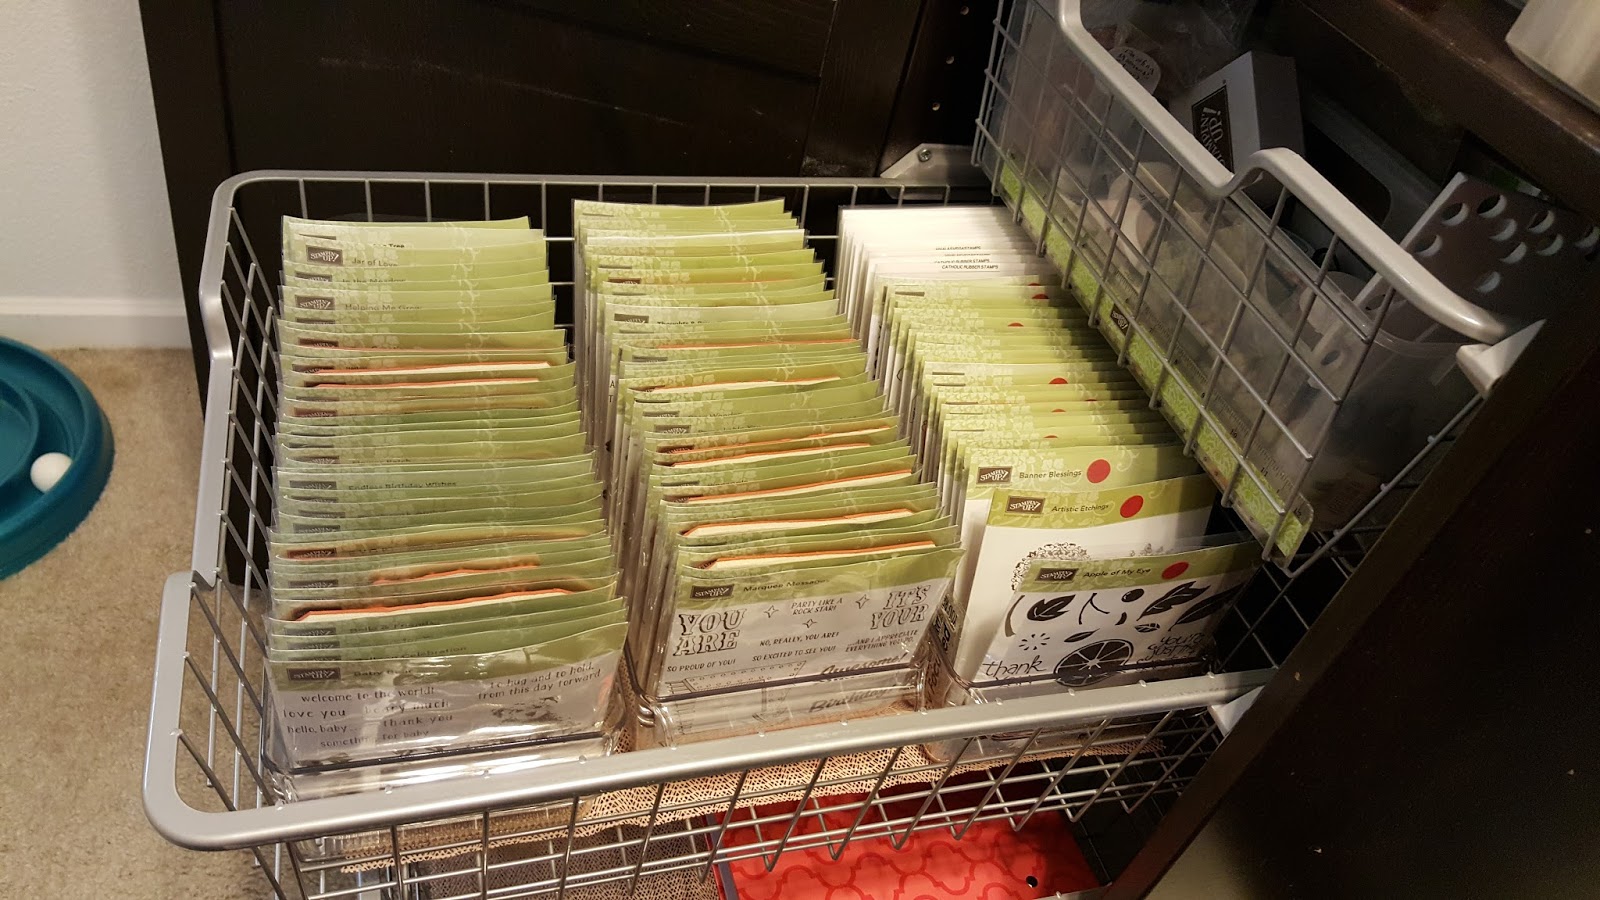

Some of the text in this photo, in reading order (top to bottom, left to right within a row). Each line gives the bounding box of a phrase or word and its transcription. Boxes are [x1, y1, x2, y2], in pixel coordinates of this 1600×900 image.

[1048, 469, 1082, 478] Blessings
[1080, 503, 1109, 512] Etchings
[1083, 570, 1108, 578] Apple
[743, 583, 784, 592] Marquee
[882, 584, 931, 610] IT'S
[791, 600, 816, 609] PARTY
[818, 598, 835, 606] LIKE
[792, 607, 813, 615] ROCK
[870, 603, 929, 630] YOUR
[678, 608, 747, 636] YOU
[759, 639, 771, 647] NO,
[773, 635, 803, 645] REALLY,
[804, 633, 820, 641] YOU
[875, 629, 919, 642] APPRECIATE
[672, 629, 741, 657] ARE
[845, 642, 888, 652] EVERYTHING
[763, 650, 793, 660] EXCITED
[679, 663, 705, 671] PROUD
[982, 654, 1047, 678] thank
[531, 672, 551, 683] and
[556, 670, 566, 678] to
[478, 668, 601, 700] from this day forward
[301, 693, 353, 703] welcome
[357, 692, 369, 700] to
[283, 709, 314, 718] love
[320, 708, 346, 719] you
[383, 714, 453, 727] thank you
[287, 725, 317, 734] hello,
[382, 732, 398, 740] for
